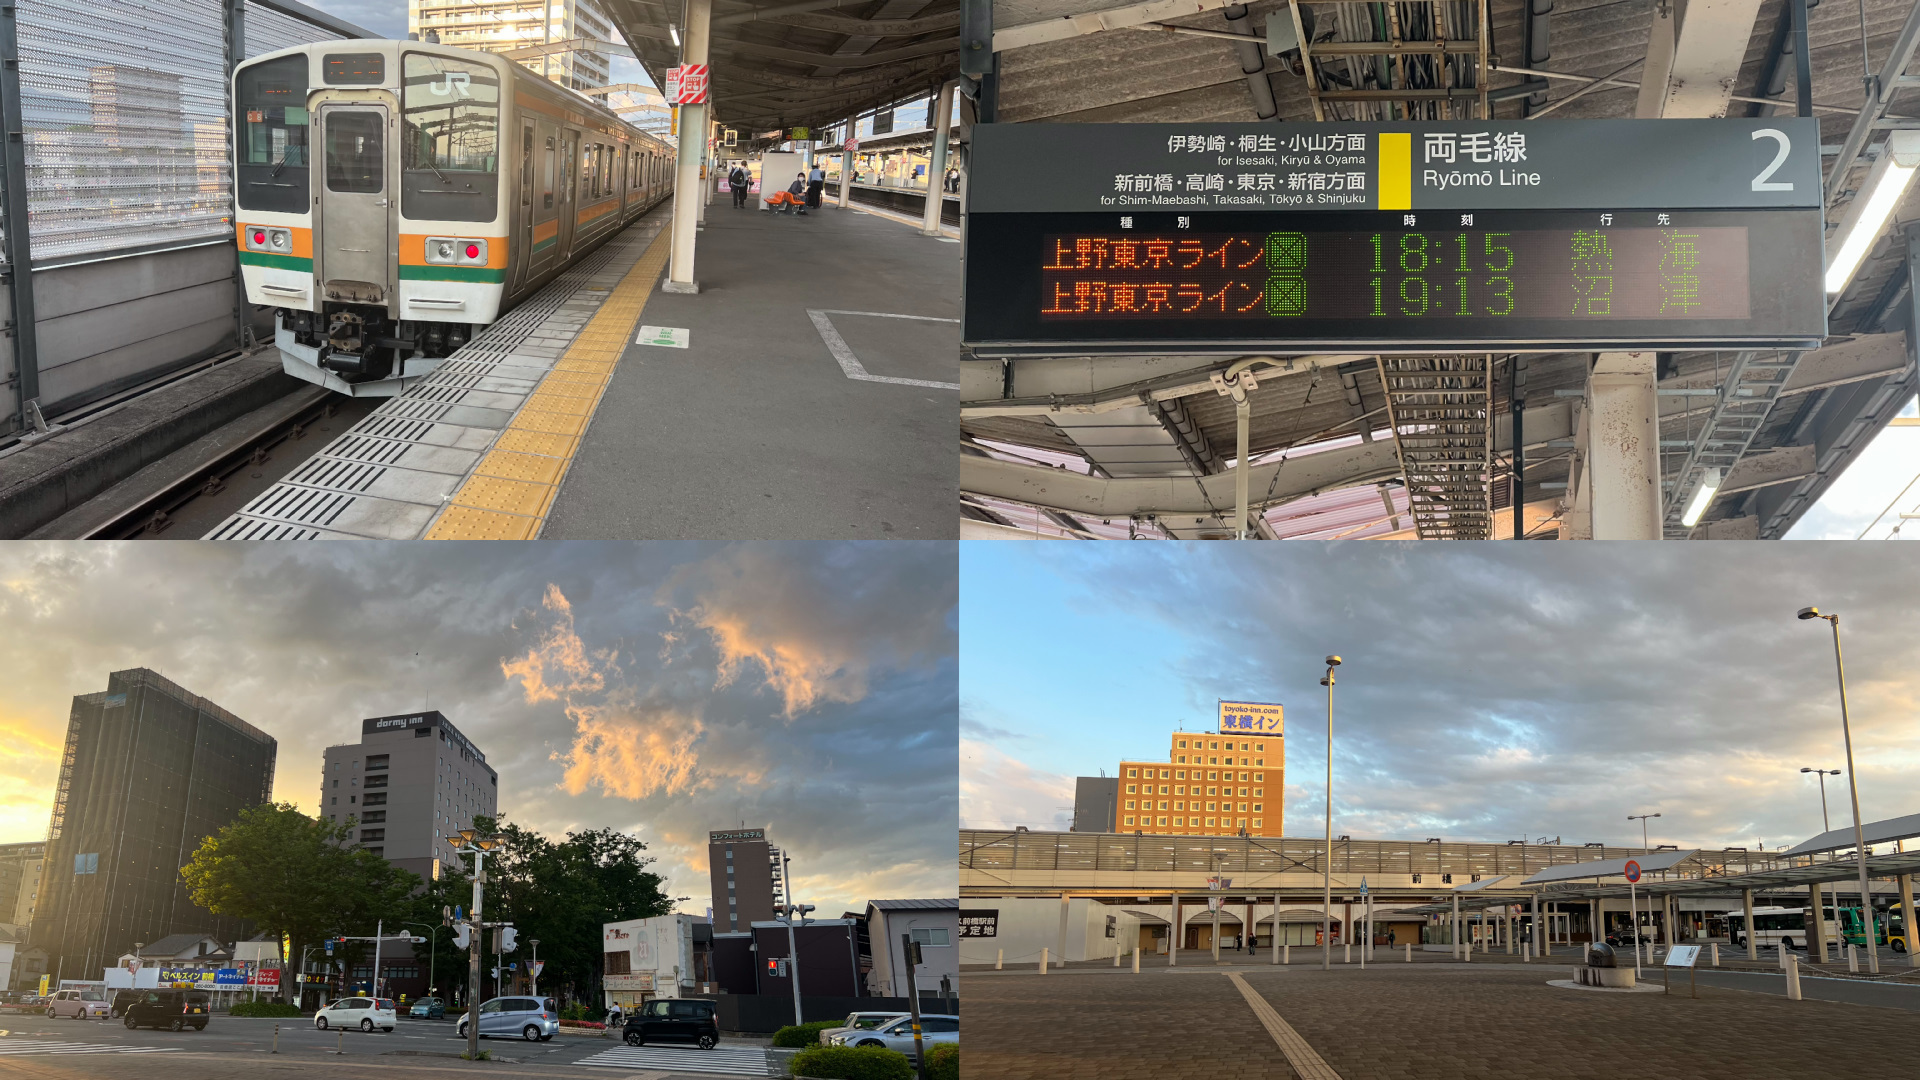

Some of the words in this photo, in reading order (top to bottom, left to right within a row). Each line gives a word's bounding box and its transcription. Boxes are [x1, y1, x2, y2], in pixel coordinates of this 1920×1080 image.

[430, 71, 471, 97] JR
[1167, 133, 1367, 154] 伊勢崎・桐生・小山方面
[1423, 131, 1528, 164] 両毛線
[1217, 155, 1233, 166] for
[1236, 155, 1278, 167] Isesaki,
[1281, 154, 1310, 168] Kiryū
[1313, 155, 1322, 165] &
[1325, 154, 1366, 168] Oyama
[1751, 128, 1795, 192] 2
[1114, 171, 1366, 192] 新前橋・高崎・東京・新宿方面
[1423, 169, 1493, 191] Ryōmō
[1499, 168, 1541, 187] Line
[1100, 194, 1117, 206] for
[1118, 194, 1209, 207] Shim-Maebashi,
[1212, 193, 1266, 207] Takasaki,
[1268, 192, 1303, 207] Tōkyō
[1305, 193, 1315, 204] &
[1317, 192, 1366, 206] Shinjuku
[1042, 237, 1264, 269] 上野東京ライン
[1368, 233, 1514, 273] 18:15
[1571, 229, 1701, 272] 熱海
[1041, 281, 1263, 313] 上野東京ライン
[1368, 276, 1514, 317] 19:13
[1571, 272, 1701, 315] 沼津
[1222, 714, 1280, 730] 東横イン
[1224, 705, 1279, 715] toyoko-inn.com
[376, 718, 407, 729] dormy
[409, 716, 423, 725] inn
[711, 832, 762, 840] コンフォートホテル
